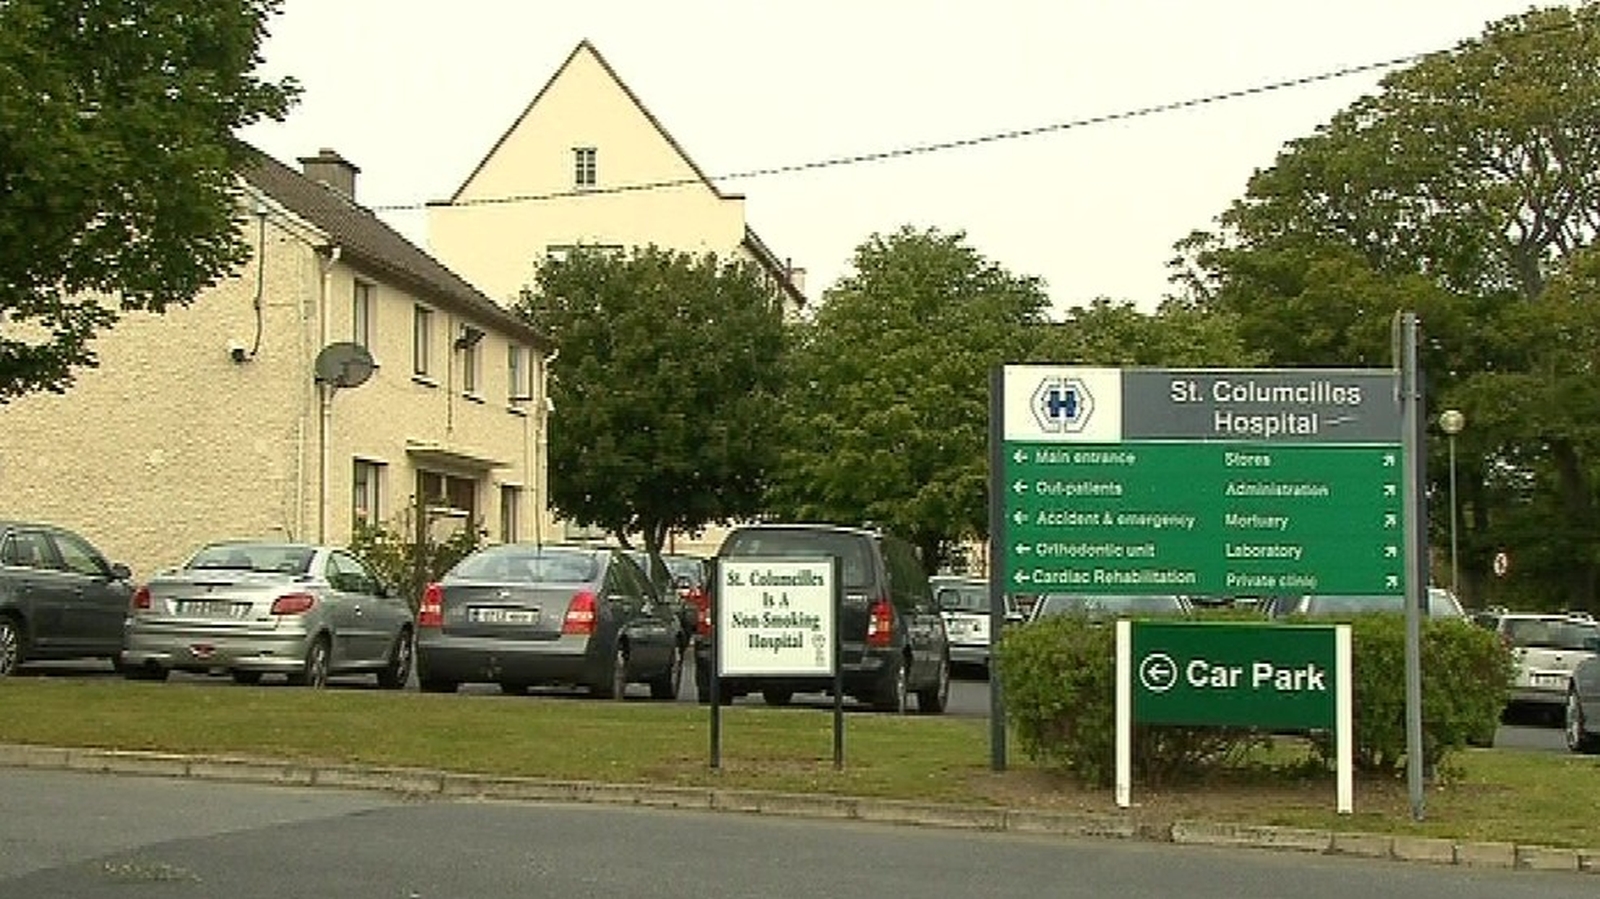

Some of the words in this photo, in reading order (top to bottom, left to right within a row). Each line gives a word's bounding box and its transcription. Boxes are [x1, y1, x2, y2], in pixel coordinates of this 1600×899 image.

[1170, 381, 1203, 402] St.
[1213, 380, 1361, 404] Columcilles
[1214, 412, 1318, 435] Hospital
[1036, 451, 1070, 463] Main
[1074, 451, 1135, 464] entrance
[1225, 453, 1271, 467] Stores
[1036, 481, 1122, 496] Out-patients
[1225, 484, 1328, 496] Administration
[1036, 513, 1099, 526] Accident
[1102, 513, 1113, 525] &
[1117, 515, 1195, 529] emergency
[1225, 514, 1288, 529] Mortuary
[1036, 543, 1123, 556] Orthodontic
[1126, 544, 1155, 557] unit
[1226, 544, 1302, 559] Laboratory
[727, 569, 745, 586] St.
[750, 569, 824, 586] Columcilles
[1033, 570, 1090, 583] Cardiac
[1095, 570, 1195, 584] Rehabilitation
[1226, 574, 1274, 587] Private
[1278, 574, 1317, 589] clinic
[763, 592, 775, 606] Is
[779, 592, 789, 606] A
[749, 631, 803, 654] Hospital
[1186, 660, 1242, 687] Car
[1252, 663, 1326, 691] Park
